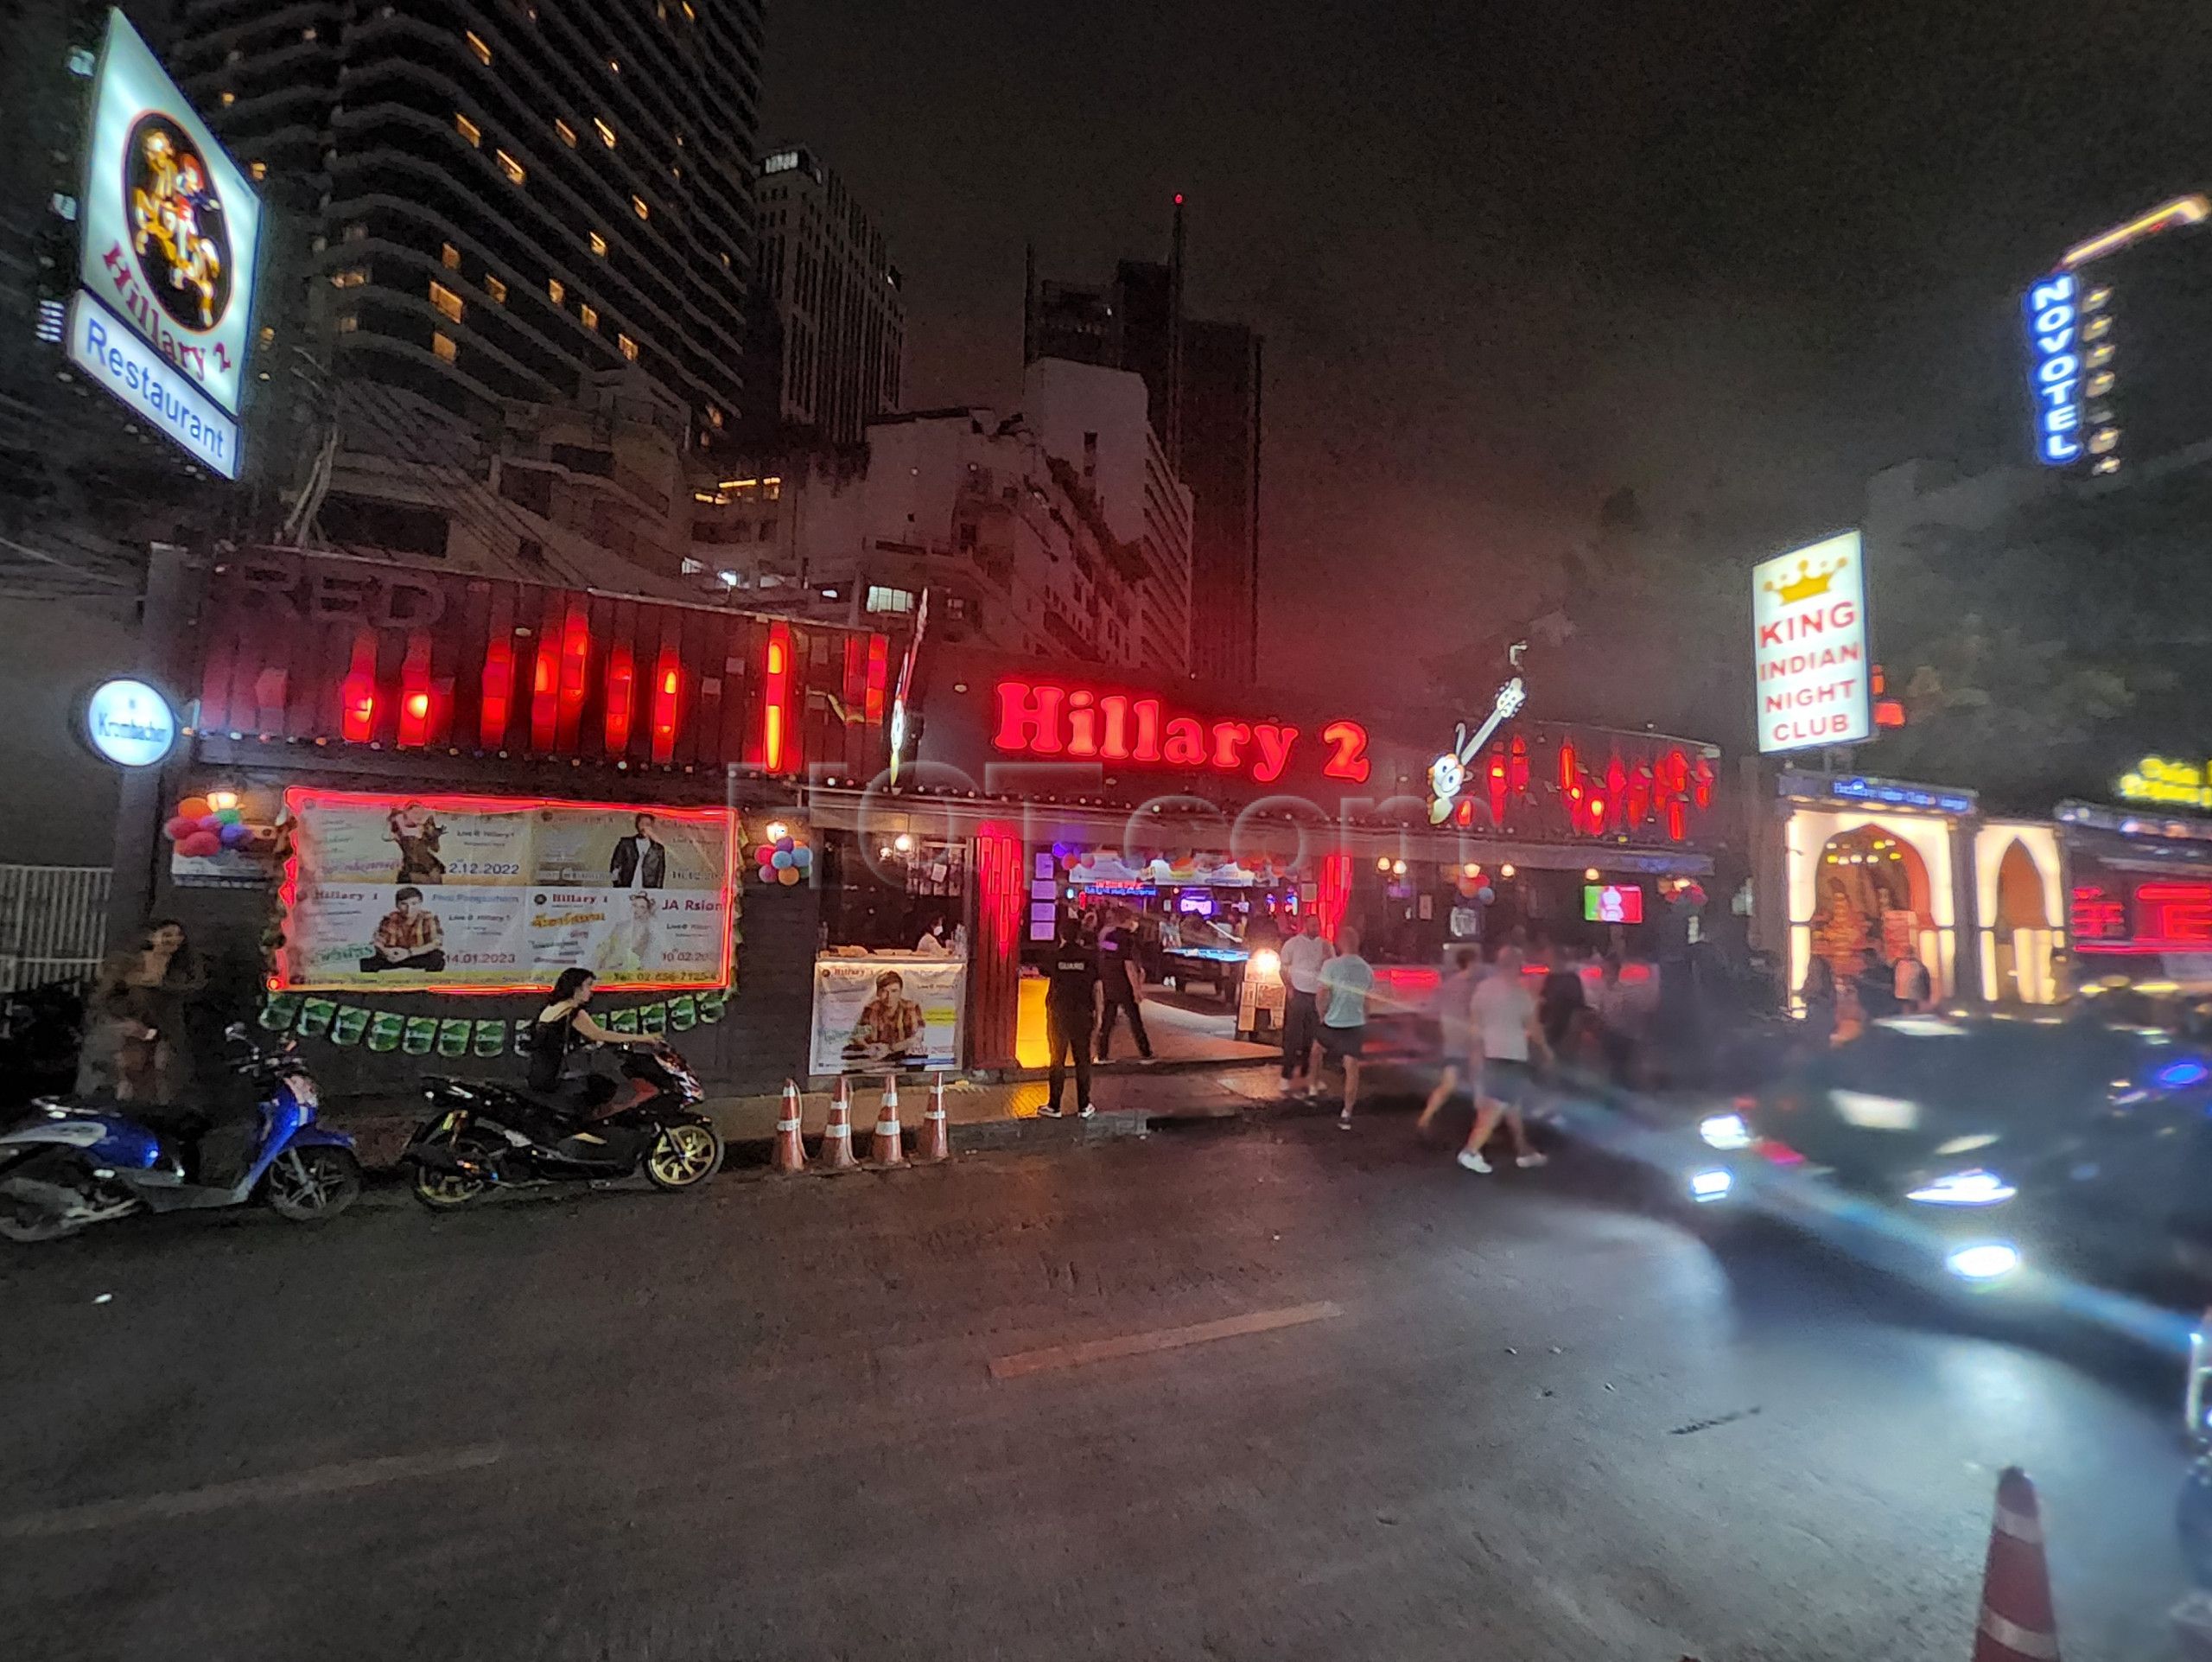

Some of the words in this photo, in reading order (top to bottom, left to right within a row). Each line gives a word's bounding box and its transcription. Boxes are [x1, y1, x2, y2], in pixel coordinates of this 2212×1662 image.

[102, 239, 206, 382] Hillary
[2031, 275, 2077, 458] NOVOTEL
[87, 317, 225, 460] Restaurant
[1758, 600, 1857, 648] KING
[1759, 642, 1860, 682] INDIAN
[1764, 678, 1857, 714] NIGHT
[994, 681, 1299, 782] Hillary
[1322, 719, 1370, 782] 2
[1772, 714, 1849, 742] CLUB
[315, 890, 365, 901] Hillary
[552, 894, 597, 904] Hillary
[661, 899, 679, 911] JA
[445, 953, 516, 965] 14.01.2023
[1058, 961, 1084, 971] GUARD
